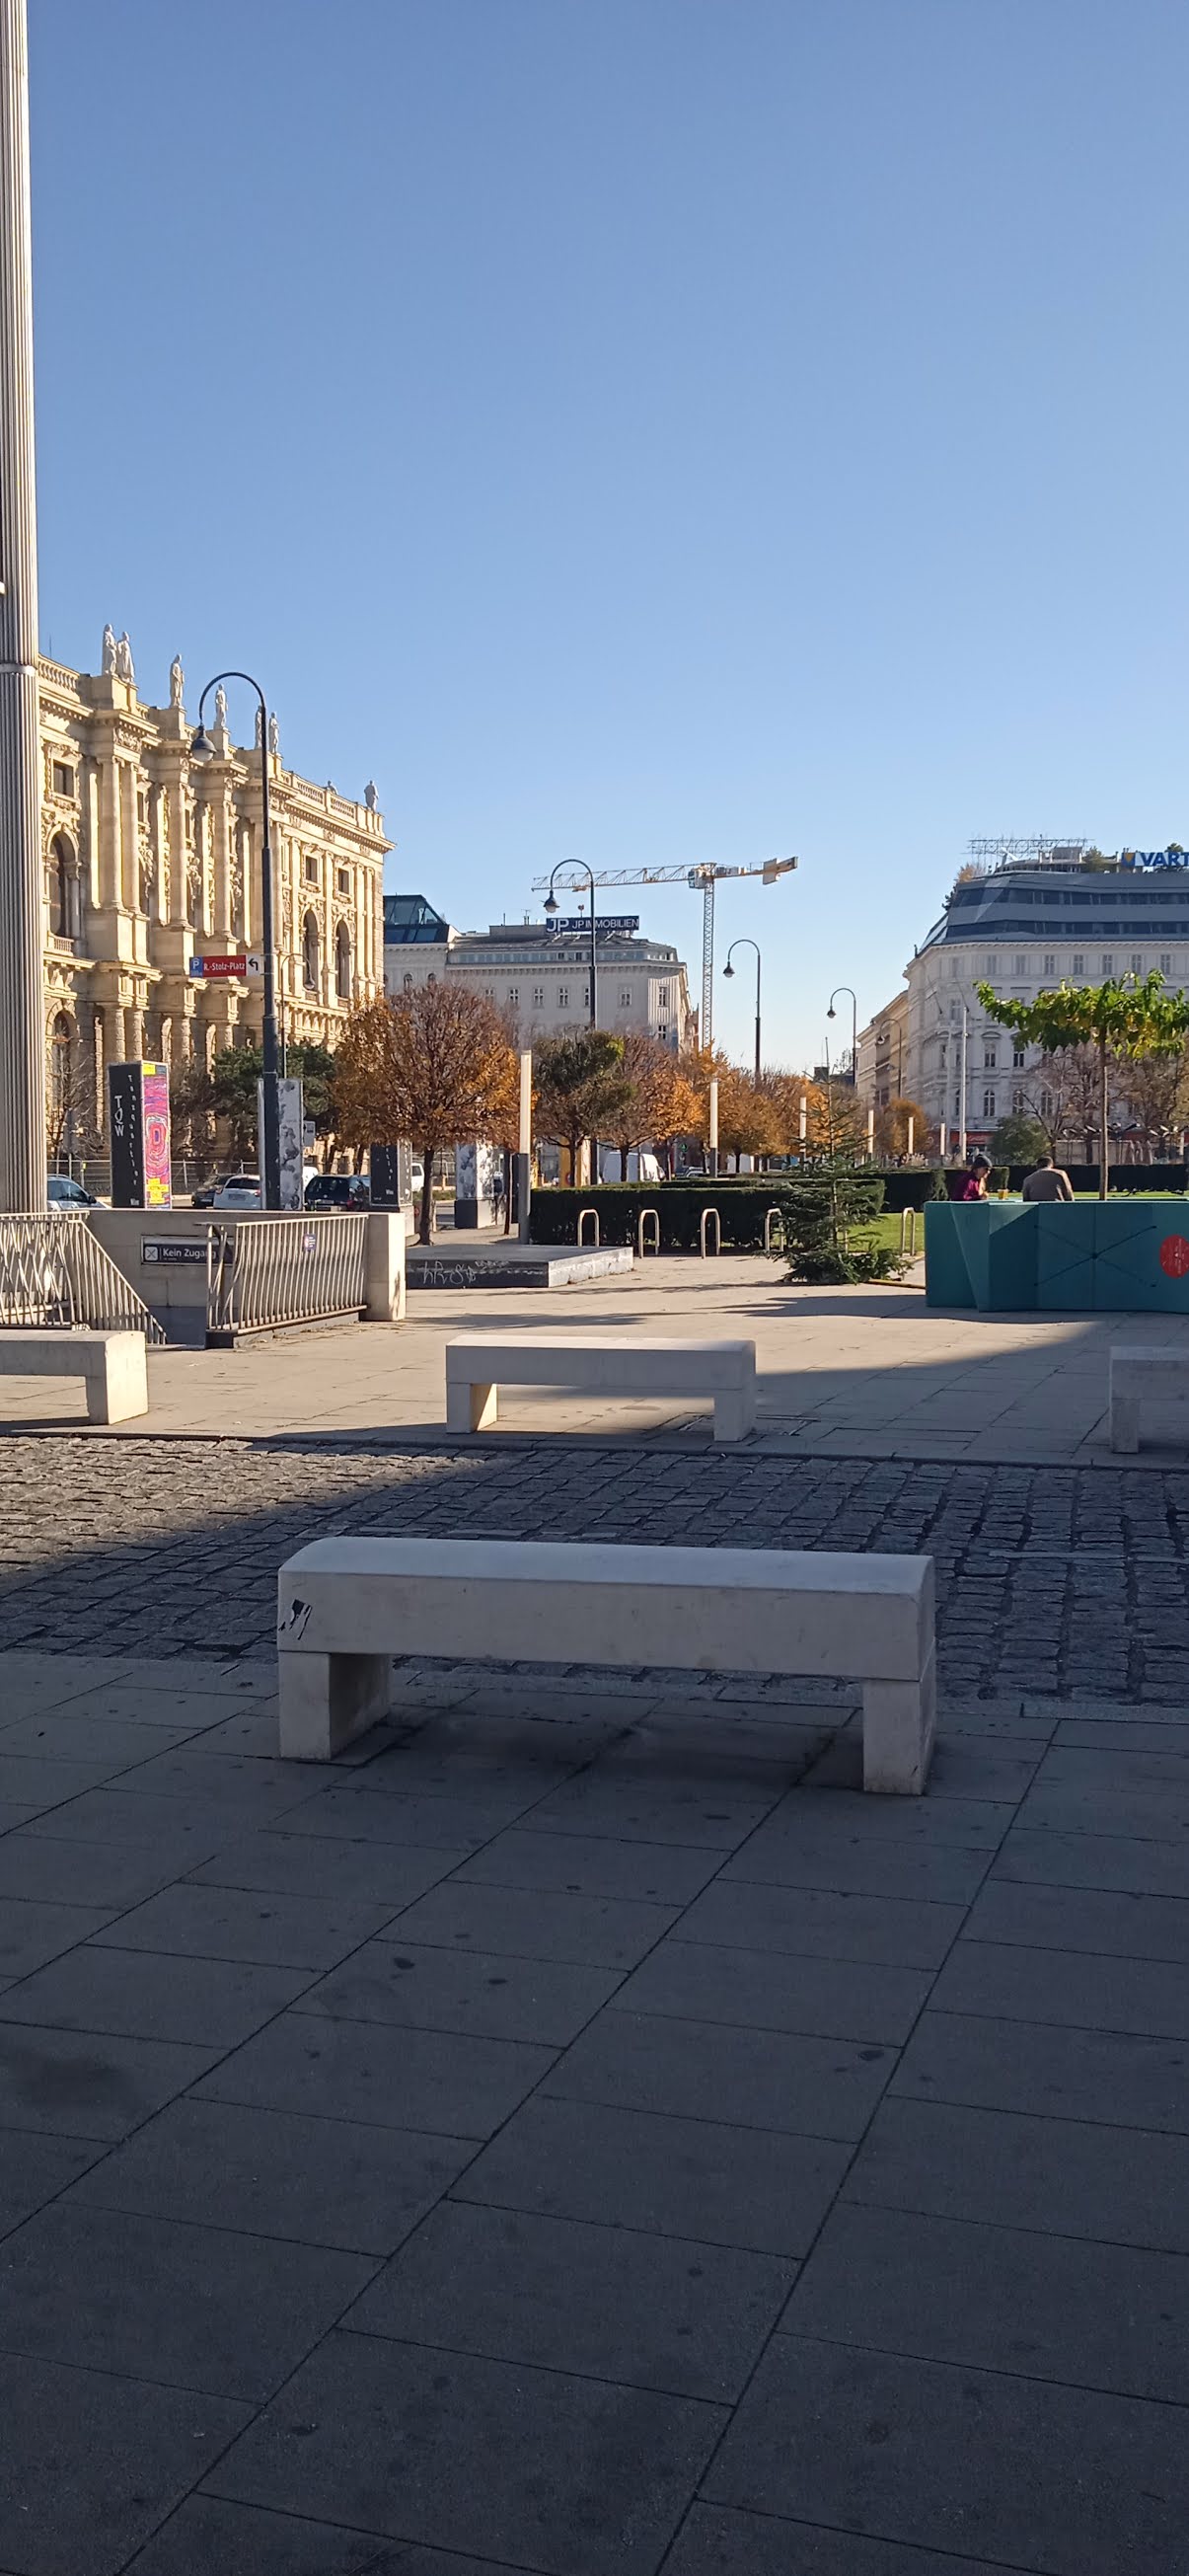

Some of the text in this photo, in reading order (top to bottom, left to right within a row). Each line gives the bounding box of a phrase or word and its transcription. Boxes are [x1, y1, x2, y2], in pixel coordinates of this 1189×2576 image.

[1140, 852, 1189, 867] VART
[547, 918, 569, 932] JP
[572, 920, 584, 929] JP
[192, 960, 200, 969] P
[203, 962, 245, 971] R.-Stolz-Platz
[114, 1096, 124, 1136] TQW
[163, 1248, 182, 1257] Kein
[184, 1248, 217, 1259] Zugag
